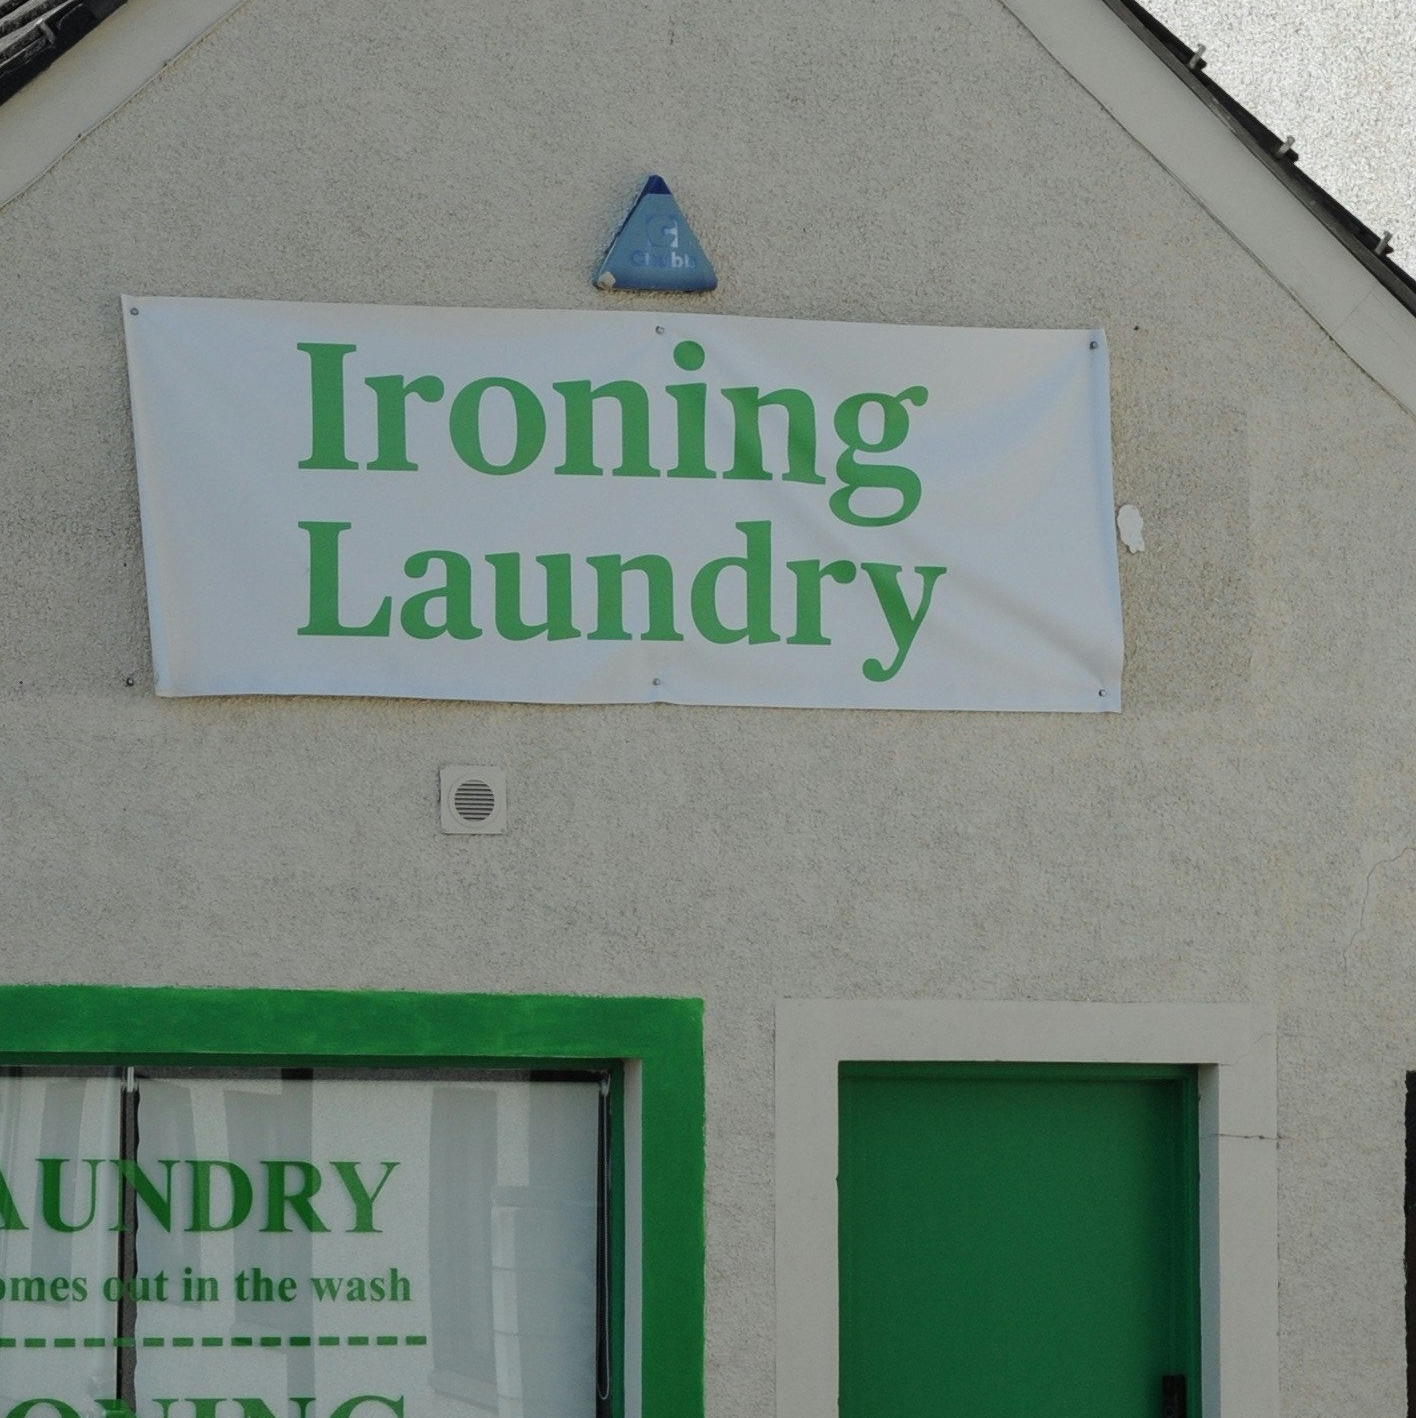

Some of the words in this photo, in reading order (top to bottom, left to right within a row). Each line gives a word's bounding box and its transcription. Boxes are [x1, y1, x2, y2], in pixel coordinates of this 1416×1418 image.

[296, 339, 929, 529] Ironing
[296, 519, 948, 683] Laundry
[100, 1269, 170, 1305] out
[180, 1264, 221, 1305] in
[232, 1264, 300, 1306] the
[308, 1265, 413, 1304] wash
